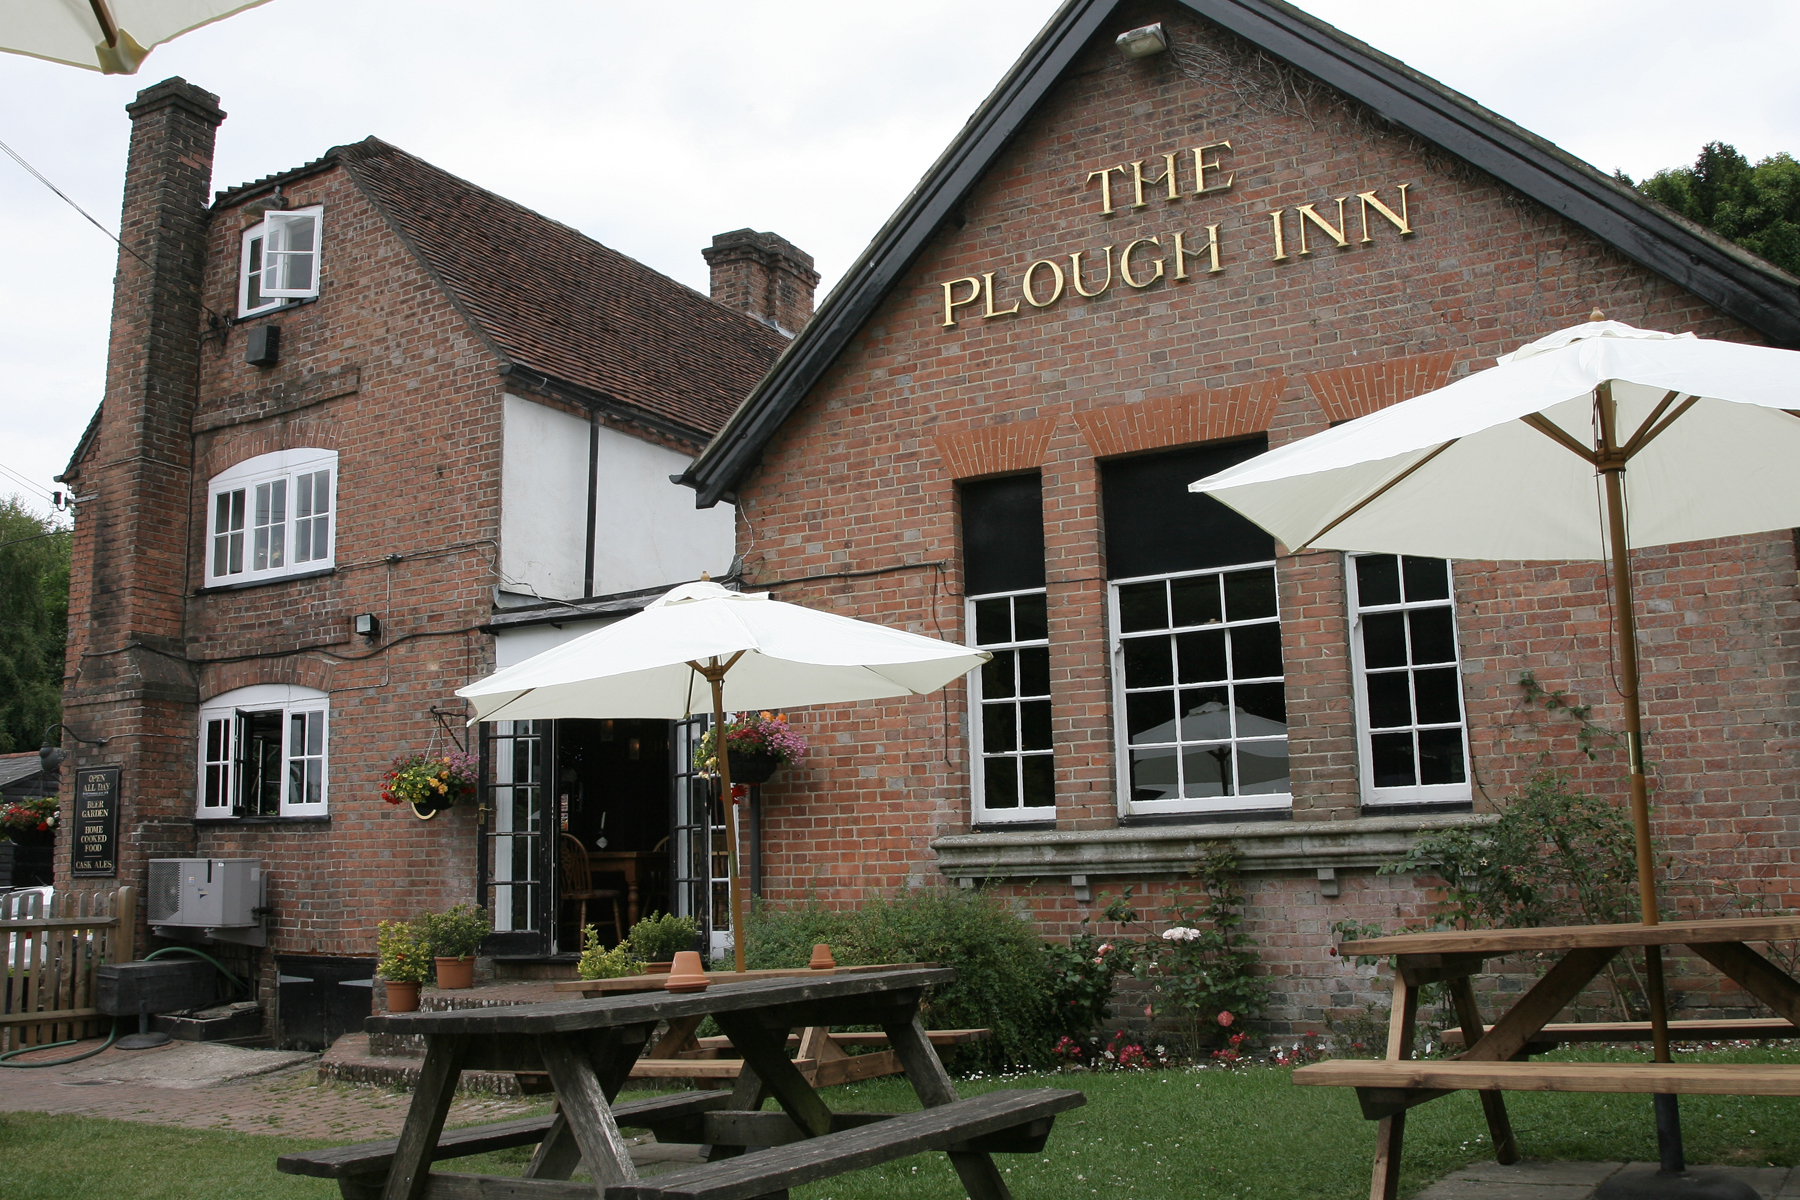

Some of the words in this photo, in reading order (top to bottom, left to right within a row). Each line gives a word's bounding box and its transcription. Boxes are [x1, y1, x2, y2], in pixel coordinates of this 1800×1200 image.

[1086, 139, 1234, 217] THE
[940, 222, 1225, 328] PLOUGH
[1269, 182, 1414, 262] INN
[88, 774, 106, 783] OPEN
[83, 784, 96, 792] ALL
[97, 782, 110, 791] DAY
[87, 800, 104, 809] BEER
[81, 809, 109, 818] GARDEN
[84, 826, 104, 834] HOME
[80, 834, 107, 844] COOKED
[84, 844, 102, 852] FOOD
[75, 861, 92, 869] CASK
[94, 860, 113, 869] ALES
